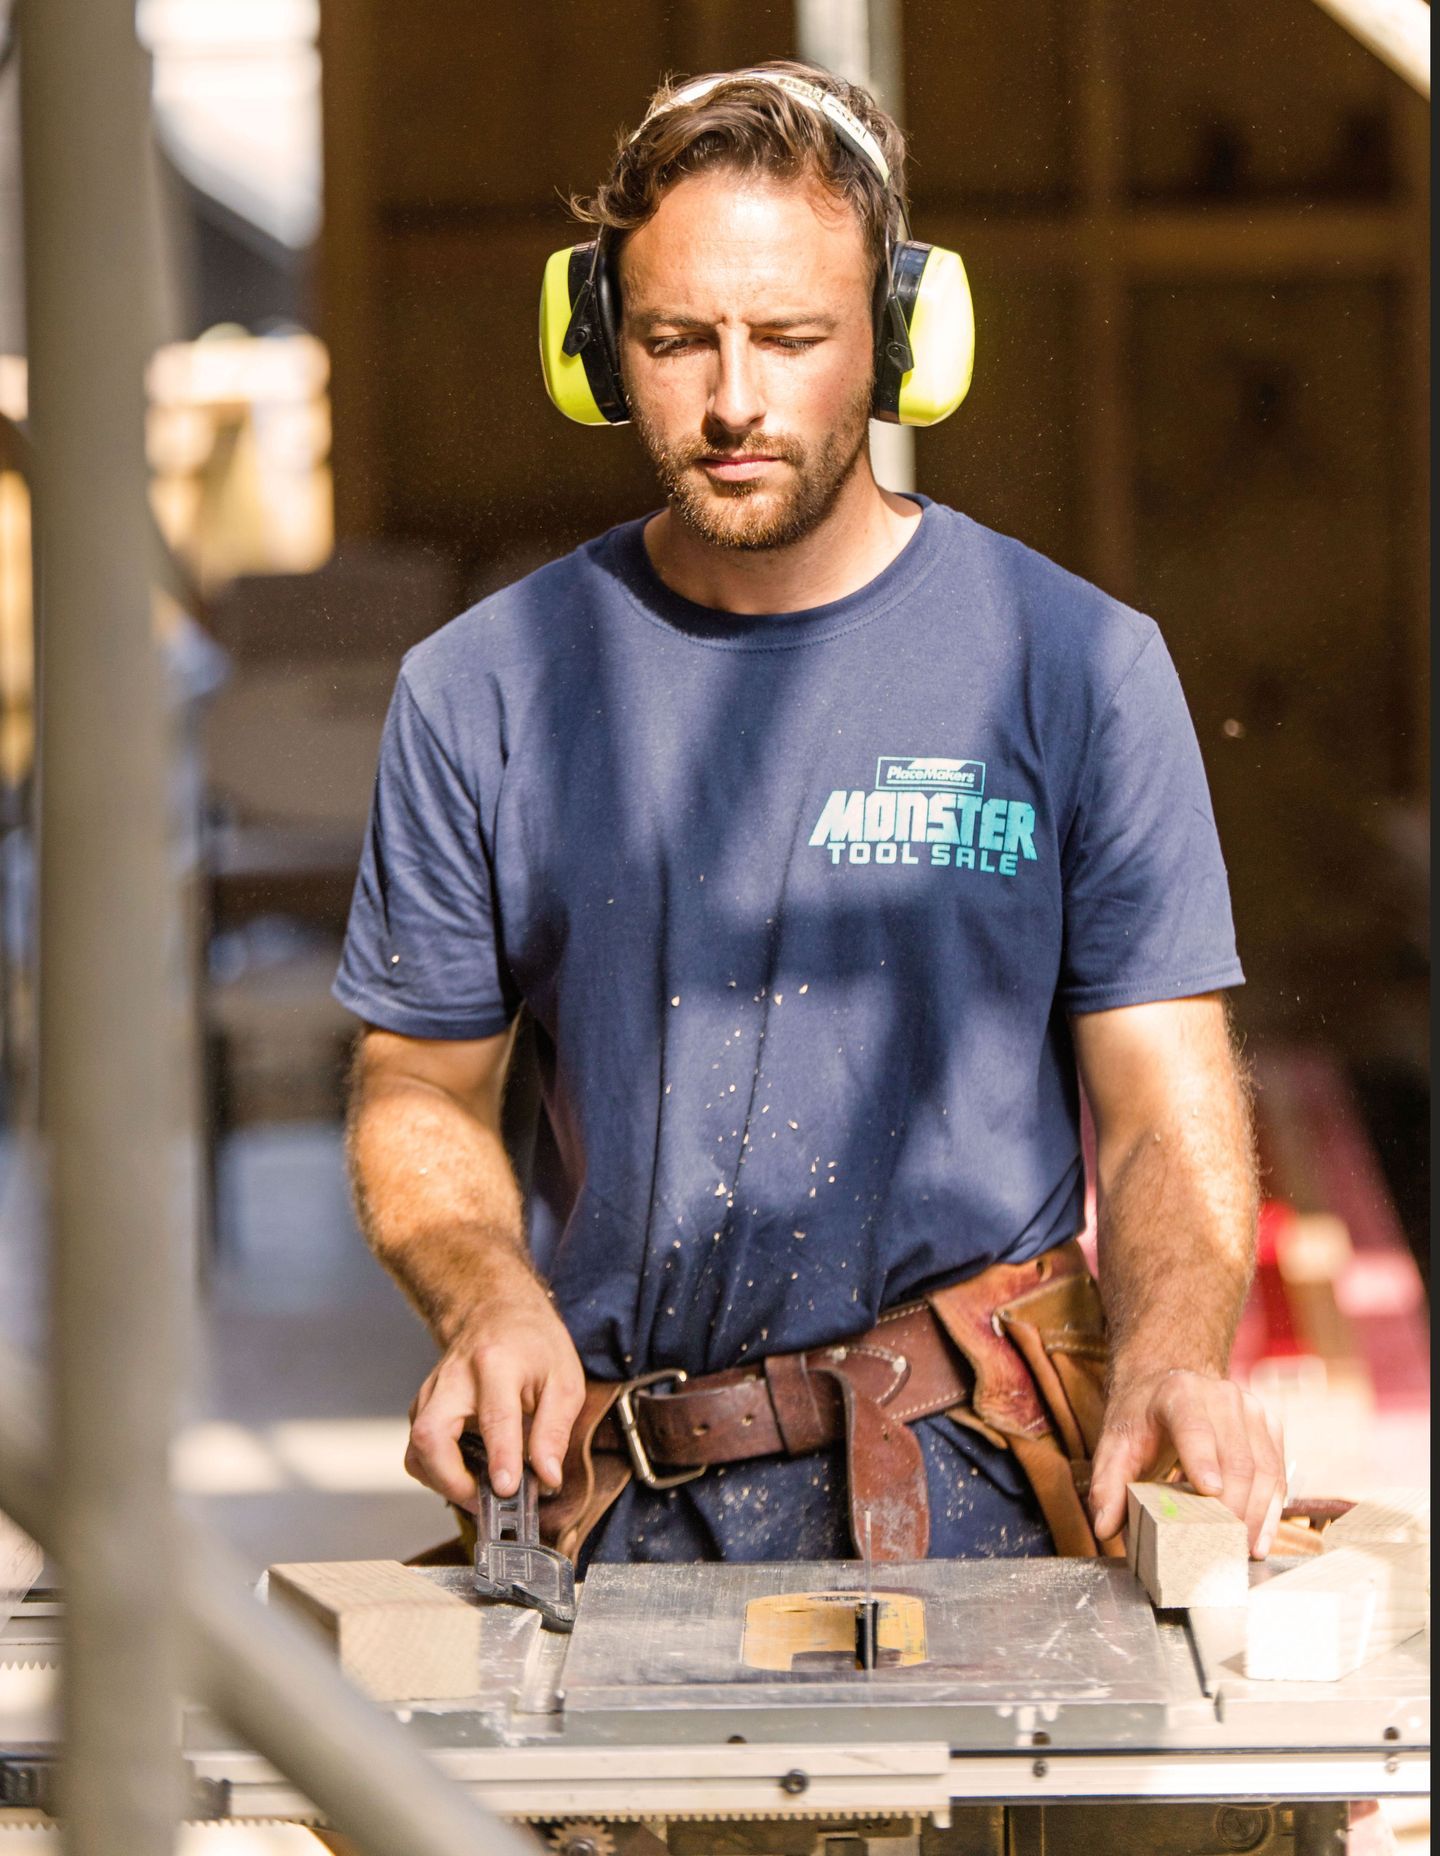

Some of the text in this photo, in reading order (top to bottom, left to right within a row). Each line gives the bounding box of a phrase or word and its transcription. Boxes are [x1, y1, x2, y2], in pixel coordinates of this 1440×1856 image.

[886, 765, 975, 783] PlaceMakers
[808, 790, 1038, 860] MONSTER
[827, 842, 1018, 876] TOOL SALE
